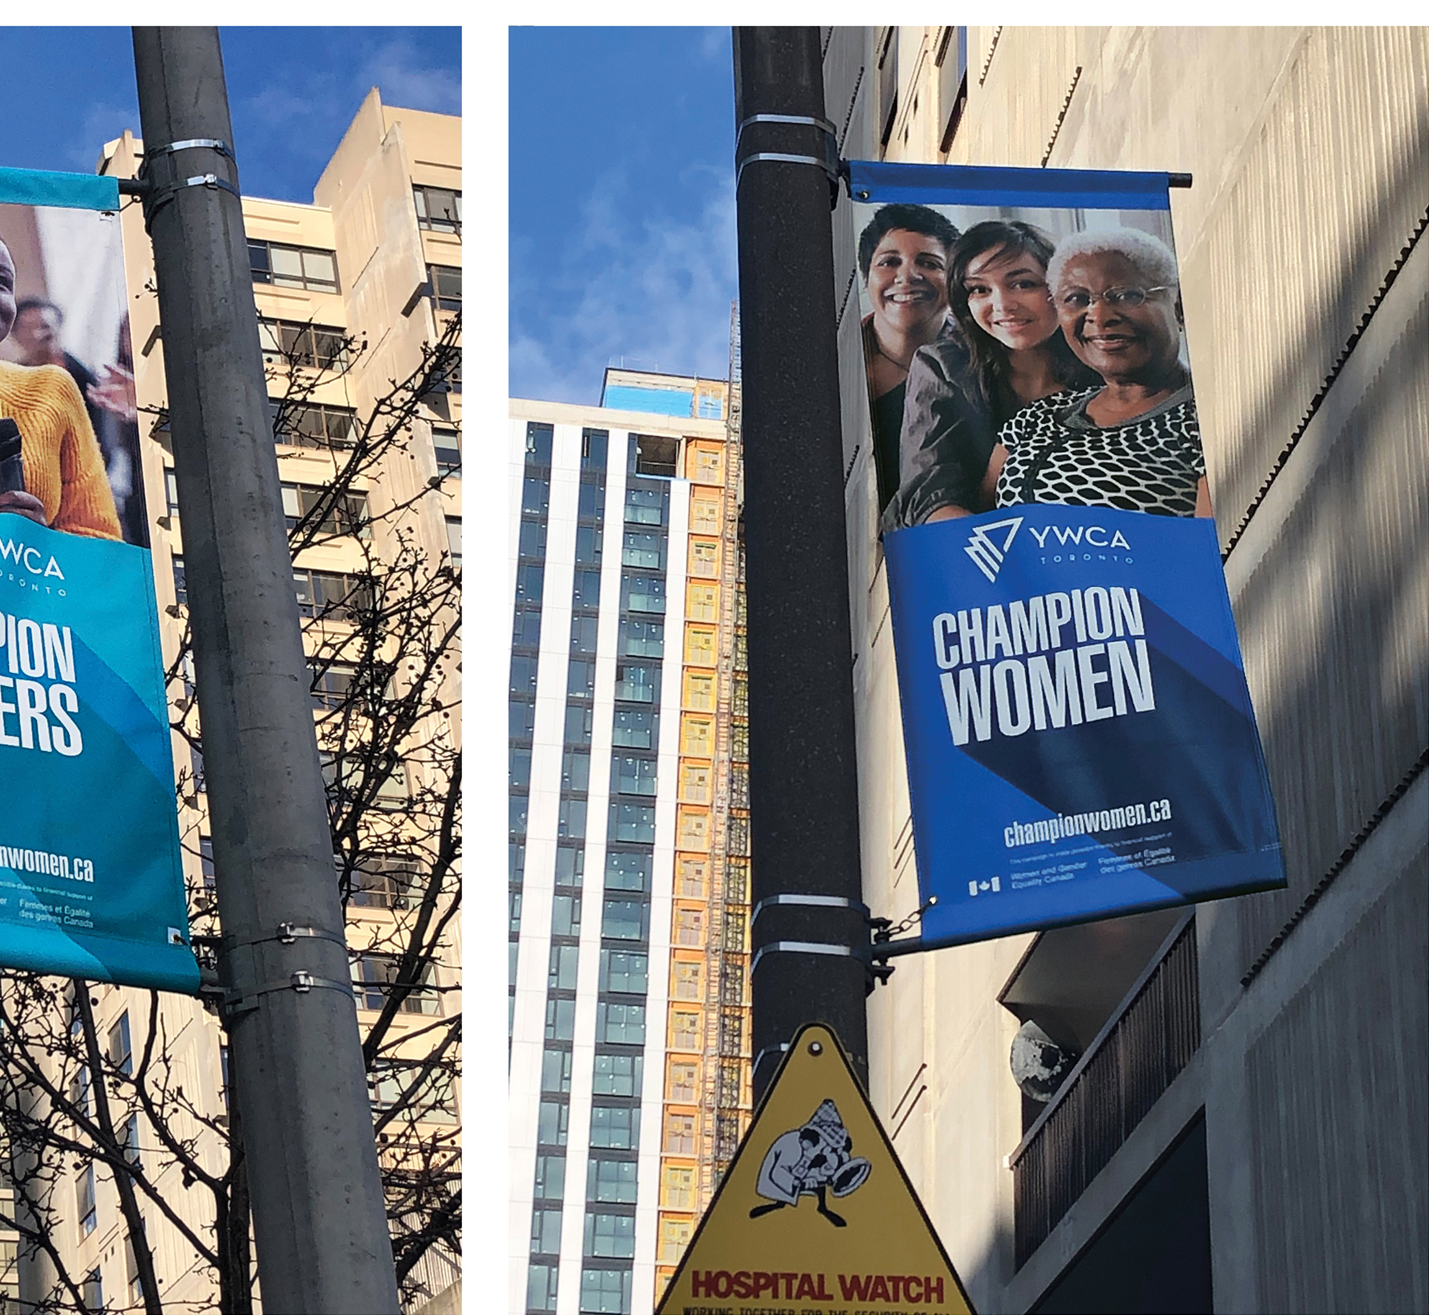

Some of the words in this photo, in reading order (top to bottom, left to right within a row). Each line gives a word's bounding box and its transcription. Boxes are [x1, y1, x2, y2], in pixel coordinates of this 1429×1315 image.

[1029, 525, 1131, 550] YWCA
[1040, 553, 1134, 565] TORONTO
[932, 586, 1145, 670] CHAMPION
[939, 639, 1156, 747] WOMEN
[1004, 799, 1172, 848] championwomen.ca
[19, 899, 53, 913] Femmes
[54, 905, 63, 914] et
[19, 910, 34, 919] des
[35, 912, 62, 923] genres
[63, 916, 94, 929] Canada
[692, 1270, 834, 1301] HOSPITAL
[837, 1274, 944, 1304] WATCH
